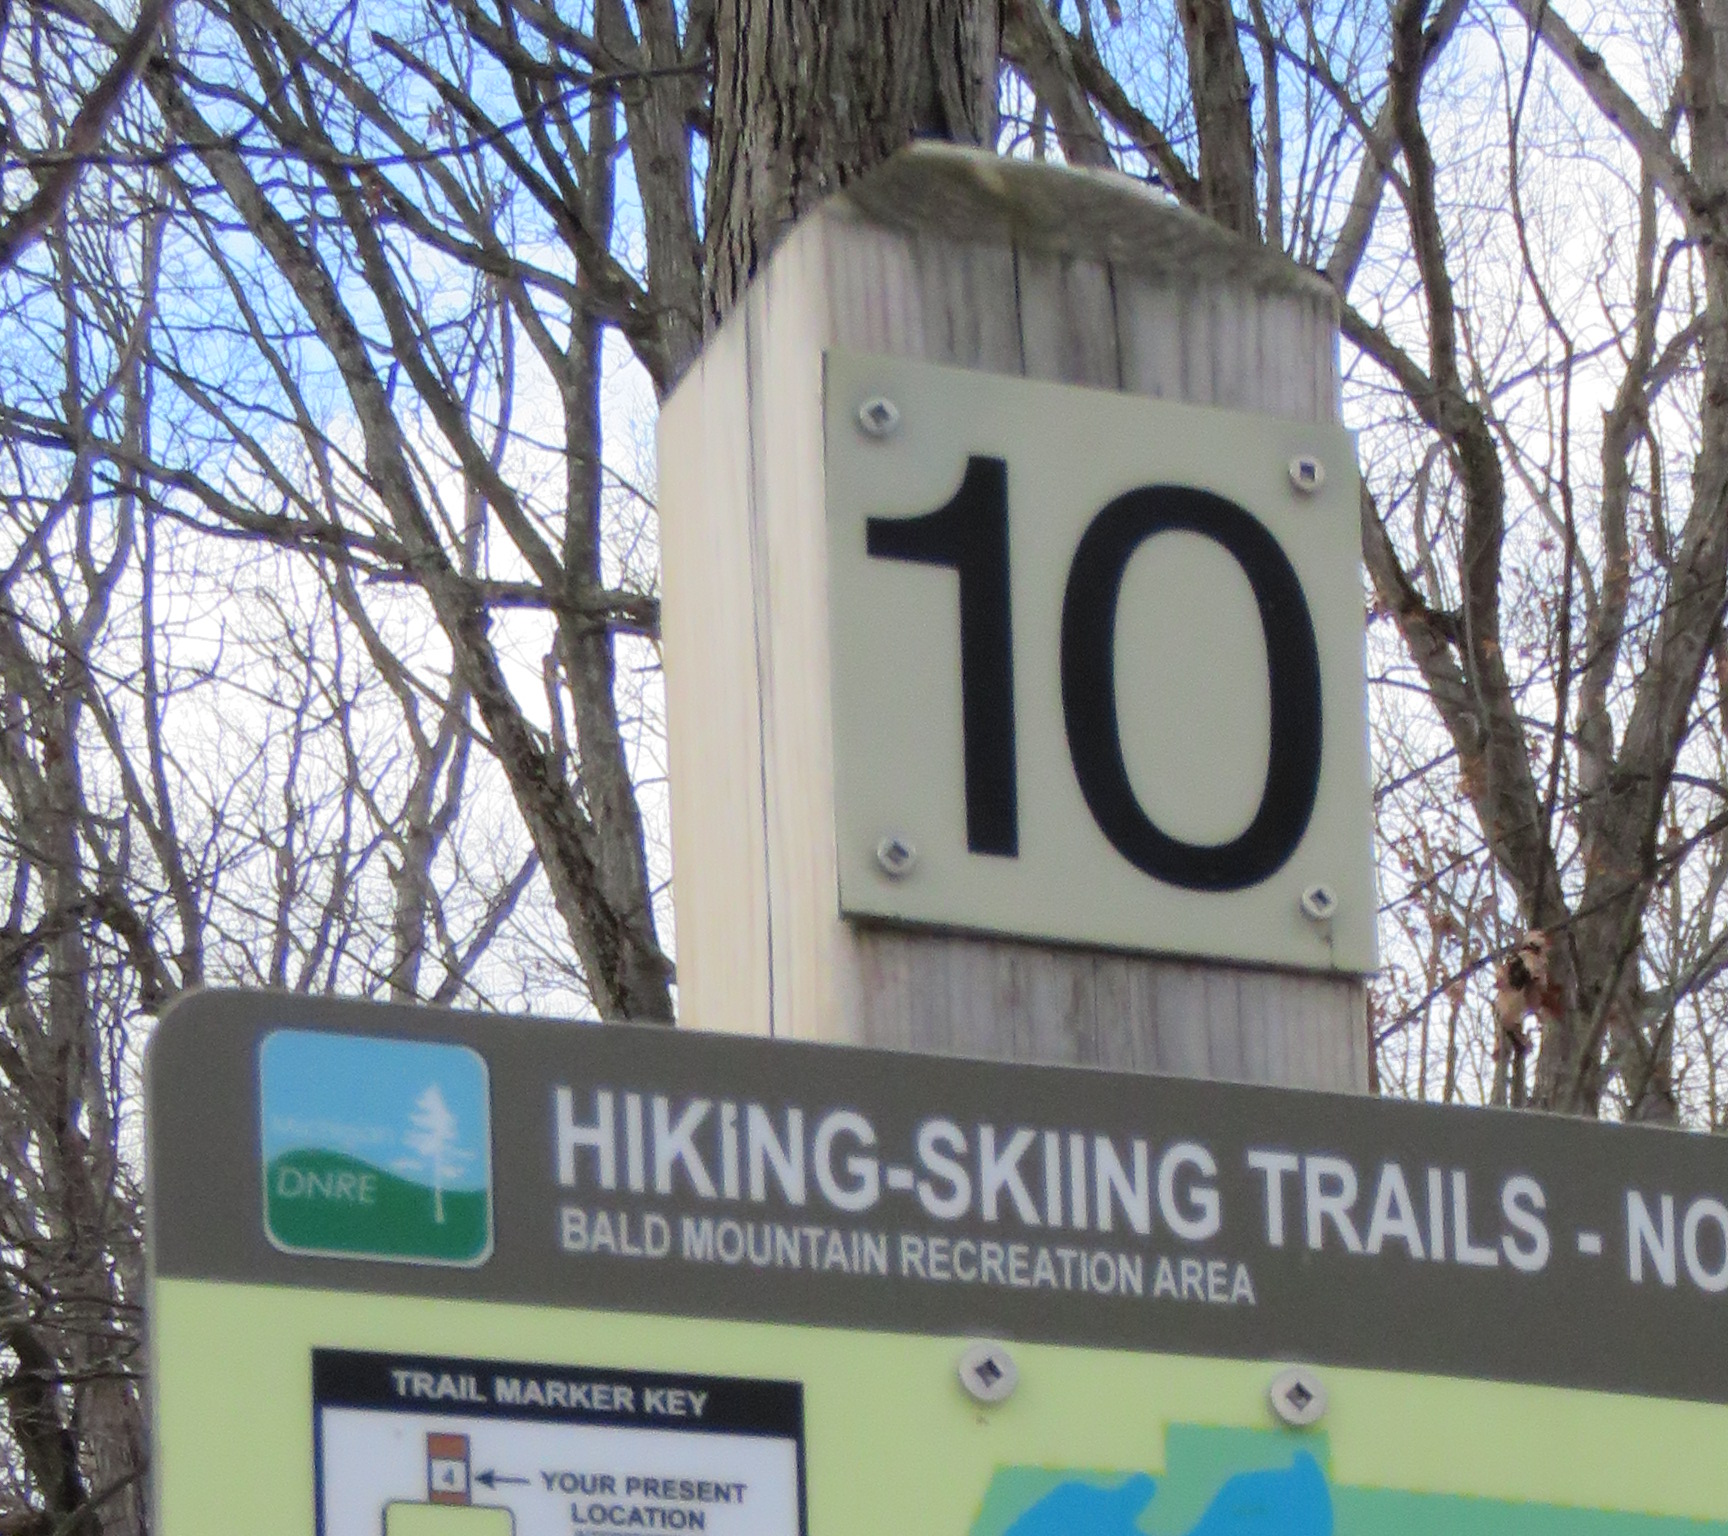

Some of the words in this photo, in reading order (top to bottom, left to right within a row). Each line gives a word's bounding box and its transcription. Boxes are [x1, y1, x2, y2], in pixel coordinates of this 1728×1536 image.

[866, 454, 1323, 893] 10
[277, 1165, 377, 1206] DNRE
[556, 1086, 1222, 1241] HIKING-SKIING
[1248, 1149, 1551, 1272] TRAILS
[1578, 1231, 1604, 1256] -
[560, 1207, 671, 1260] BALD
[682, 1216, 889, 1276] MOUNTAIN
[900, 1233, 1146, 1297] RECREATION
[1153, 1256, 1257, 1306] AREA
[391, 1369, 485, 1402] TRAIL
[494, 1376, 637, 1412] MARKER
[644, 1387, 709, 1417] KEY
[441, 1468, 455, 1487] 4
[540, 1470, 616, 1496] YOUR
[625, 1475, 748, 1504] PRESENT
[570, 1501, 706, 1531] LOCATION
